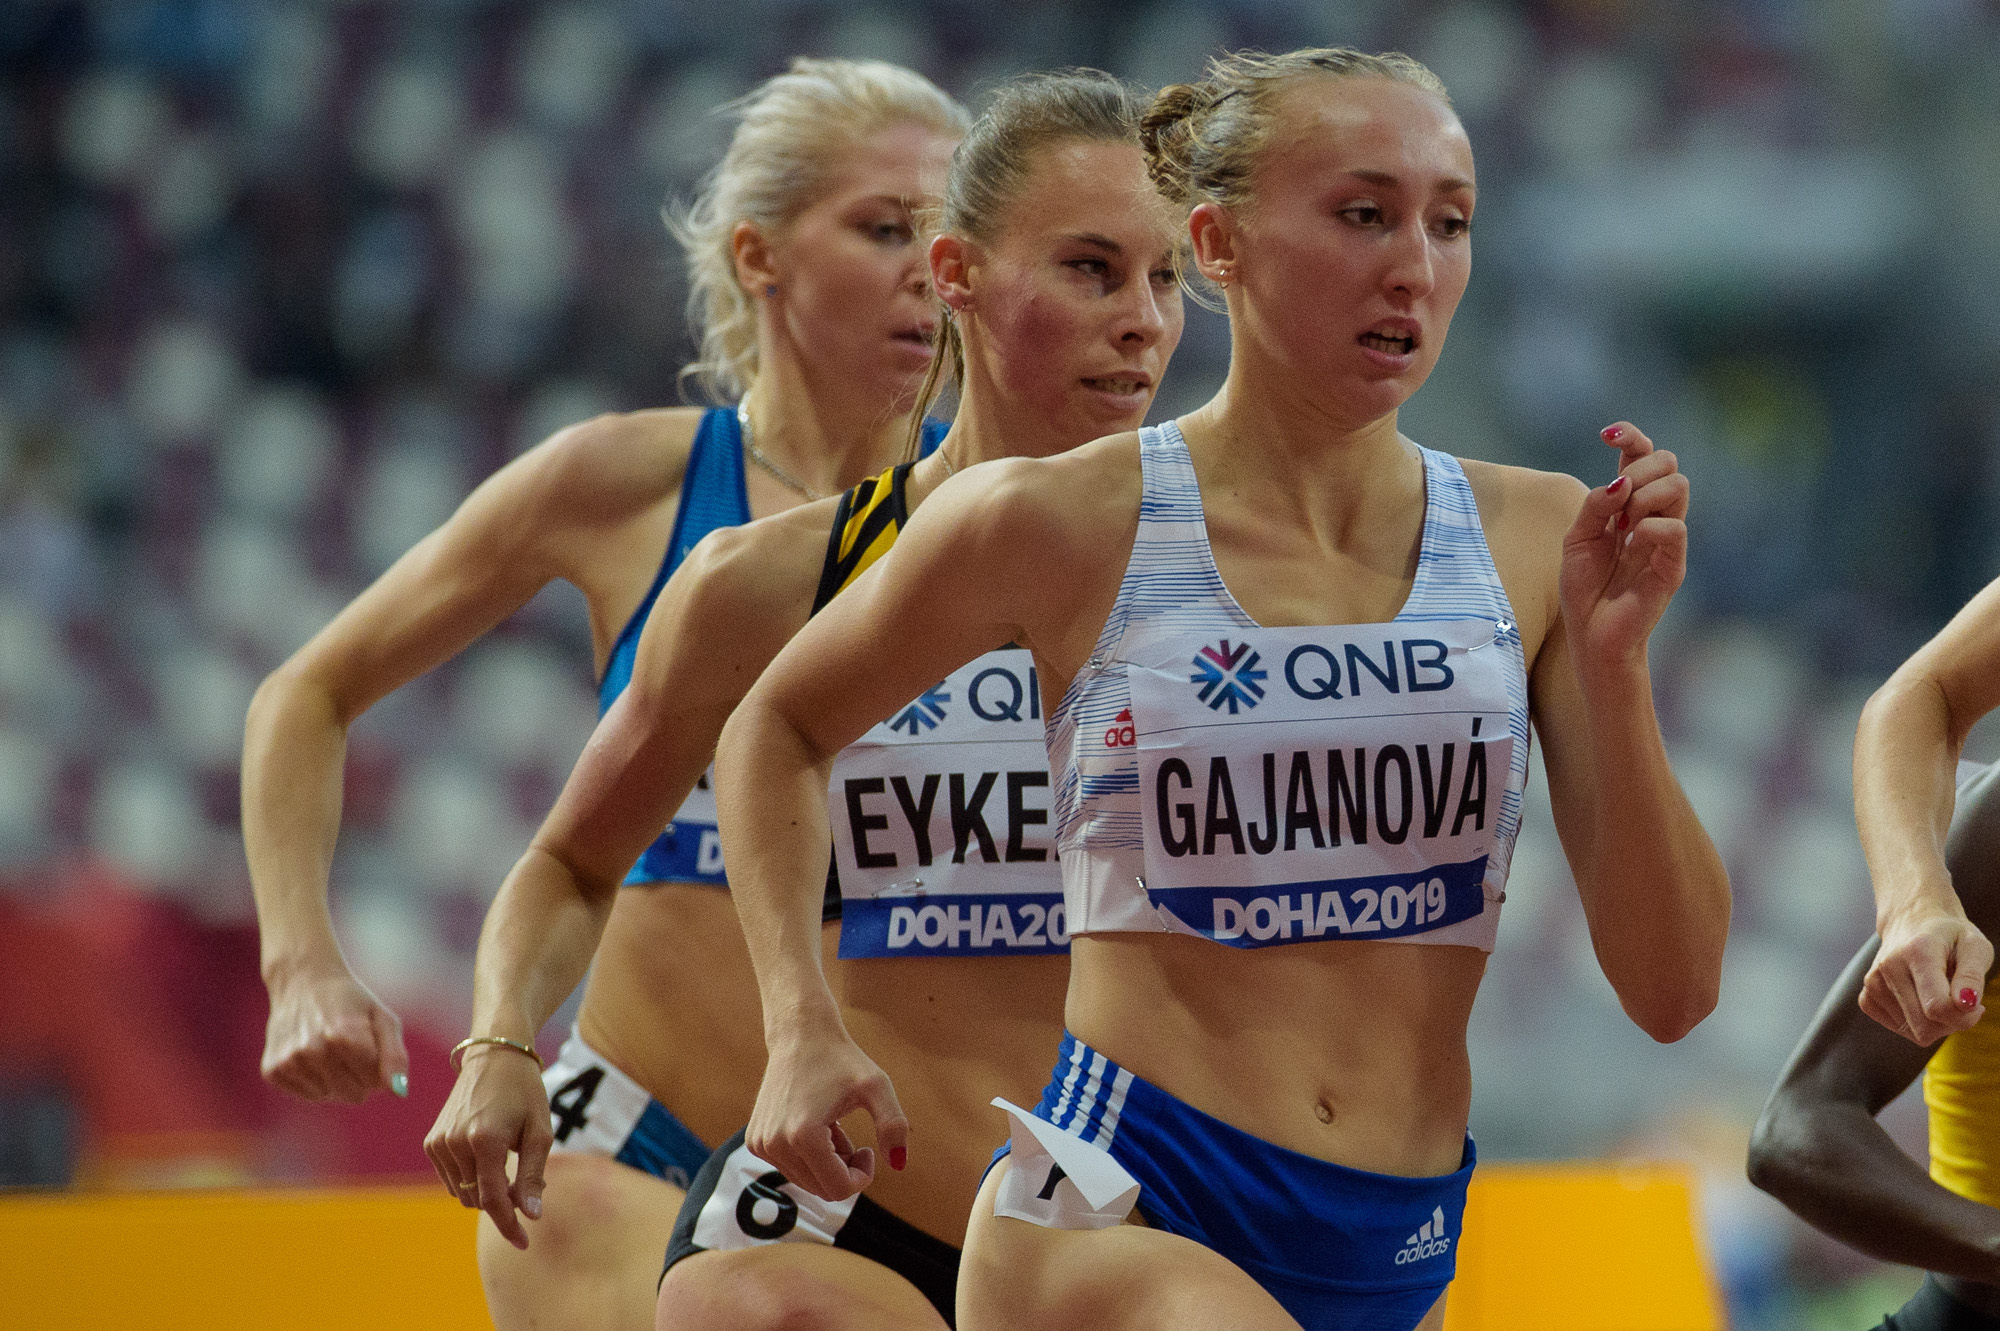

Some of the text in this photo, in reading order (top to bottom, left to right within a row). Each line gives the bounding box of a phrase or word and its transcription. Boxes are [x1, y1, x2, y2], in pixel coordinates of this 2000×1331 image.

[1284, 639, 1455, 701] QNB
[844, 771, 1060, 869] EYKE
[1156, 717, 1488, 858] GAJANOVÁ
[1213, 877, 1446, 941] DOHA2019
[550, 1065, 605, 1143] 4
[736, 1170, 798, 1239] 6
[1394, 1238, 1450, 1265] adidas
